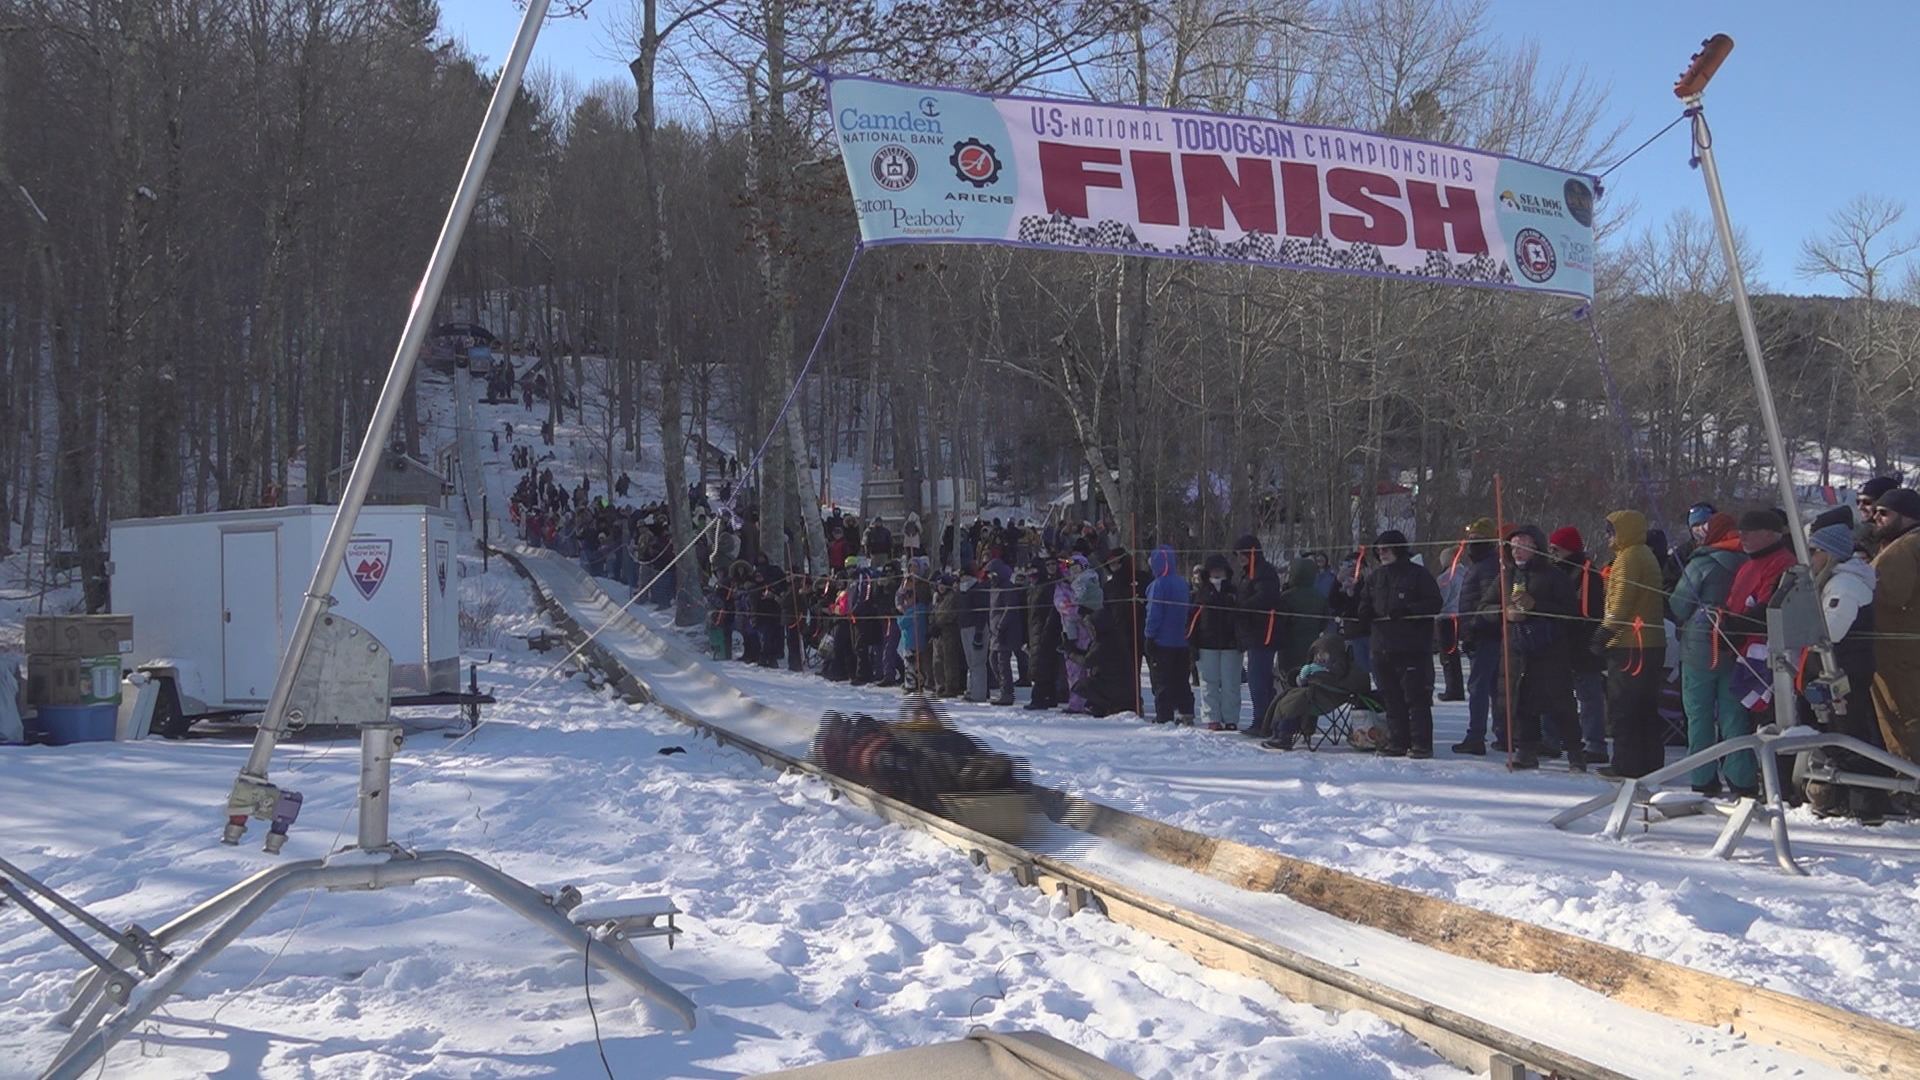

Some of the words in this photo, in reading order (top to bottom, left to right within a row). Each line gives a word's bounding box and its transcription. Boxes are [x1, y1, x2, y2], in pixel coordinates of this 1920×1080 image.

[840, 108, 944, 135] Camden
[843, 131, 906, 144] NATIONAL
[911, 133, 944, 145] BANK
[1071, 116, 1164, 142] NATIONAL
[1172, 117, 1297, 159] TOBOGGAN
[1304, 133, 1474, 183] CHAMPIONSHIPS
[944, 191, 1014, 205] ARIENS
[1038, 140, 1489, 256] FINISH
[1520, 193, 1540, 207] SEA
[1542, 197, 1563, 211] DOG
[892, 207, 965, 232] Peabody
